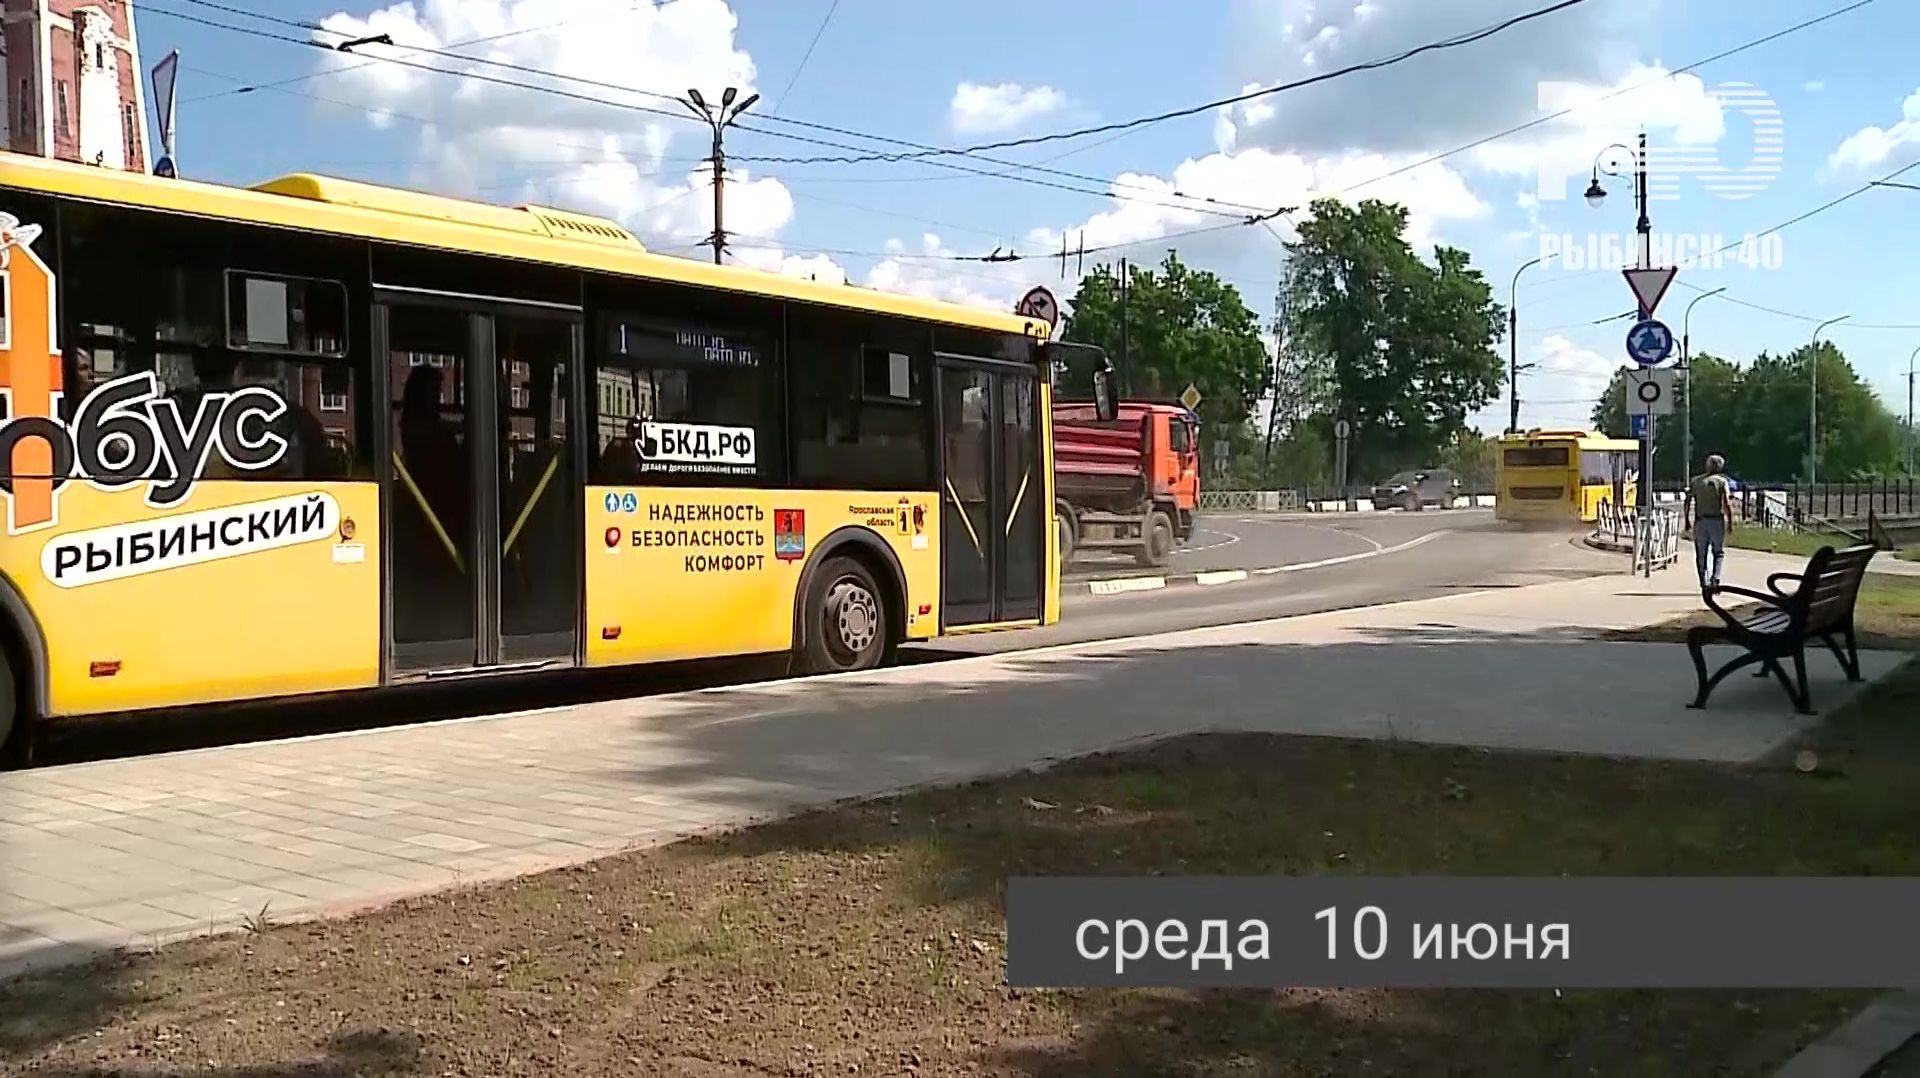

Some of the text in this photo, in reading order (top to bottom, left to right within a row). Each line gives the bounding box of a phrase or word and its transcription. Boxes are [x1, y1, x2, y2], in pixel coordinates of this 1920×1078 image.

[661, 428, 751, 459] БКД.РФ
[649, 504, 764, 524] НАДЕЖНОСТЬ
[866, 517, 895, 527] область
[55, 495, 325, 578] РЫБИНСКИЙ
[631, 530, 764, 547] БЕЗОПАСНОСТЬ
[685, 555, 764, 572] КОМФОРТ
